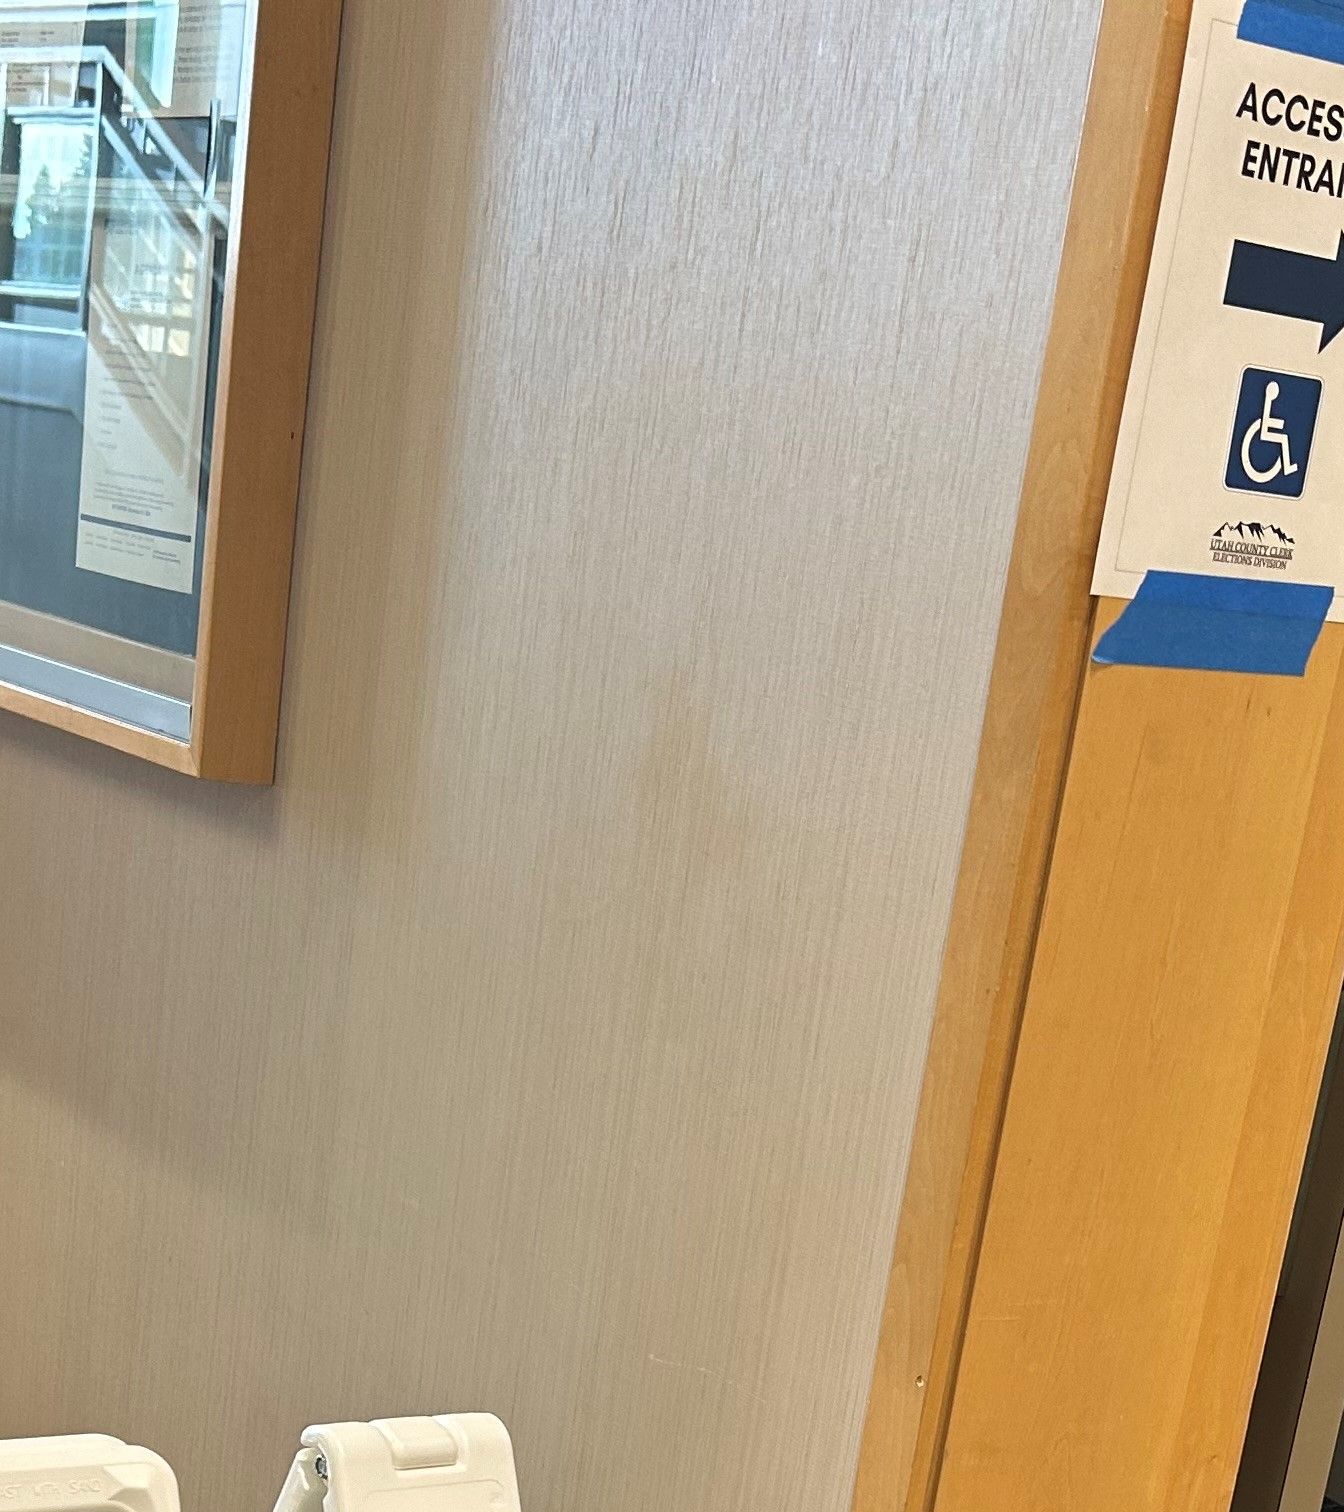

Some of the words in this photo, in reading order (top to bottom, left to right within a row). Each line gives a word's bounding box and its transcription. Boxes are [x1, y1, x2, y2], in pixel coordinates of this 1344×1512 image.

[1210, 539, 1234, 551] UTAH
[1235, 541, 1269, 556] COUNTY
[1212, 551, 1253, 566] ELECTIONS
[1253, 556, 1287, 569] DIVISION
